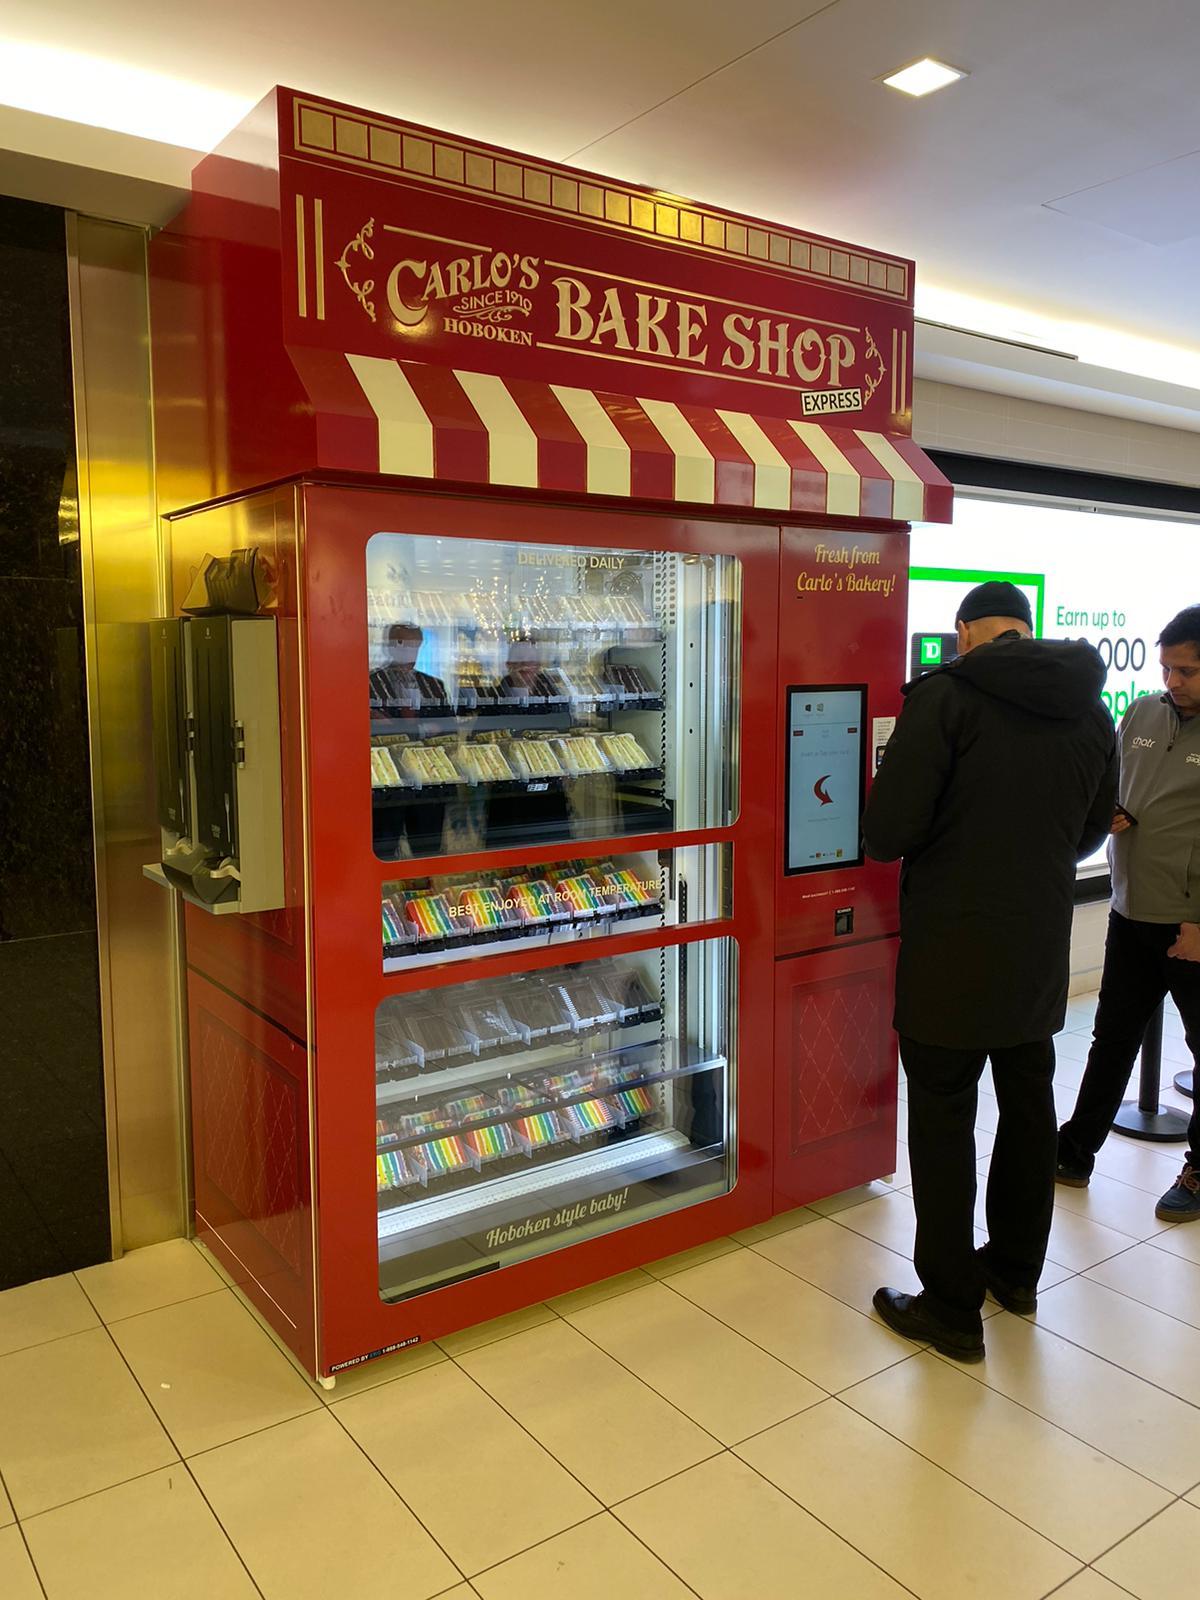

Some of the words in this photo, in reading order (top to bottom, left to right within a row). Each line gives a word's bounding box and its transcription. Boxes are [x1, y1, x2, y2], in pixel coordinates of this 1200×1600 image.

[460, 290, 503, 311] SINCE
[505, 289, 533, 312] 1910
[386, 252, 540, 327] CARLO'S
[551, 277, 708, 366] BAKE
[721, 313, 856, 387] SHOP
[443, 317, 533, 346] HOBOKEN
[803, 390, 861, 413] EXPRESS
[518, 551, 586, 568] DELIVERED
[590, 556, 625, 569] DAILY
[815, 544, 848, 563] Fresh
[847, 545, 881, 570] from
[797, 571, 843, 592] Carlo's
[846, 572, 896, 598] Bakery!
[1056, 606, 1089, 626] Earn
[1092, 611, 1110, 631] up
[1112, 610, 1126, 627] to
[449, 903, 479, 917] BEST
[484, 894, 536, 912] ENJOYED
[538, 893, 553, 905] AT
[589, 880, 662, 897] TEMPERATURE
[486, 1216, 550, 1248] Hoboken
[553, 1203, 588, 1227] style
[589, 1187, 630, 1214] baby!
[331, 1357, 361, 1372] POWERED
[360, 1354, 369, 1362] BY
